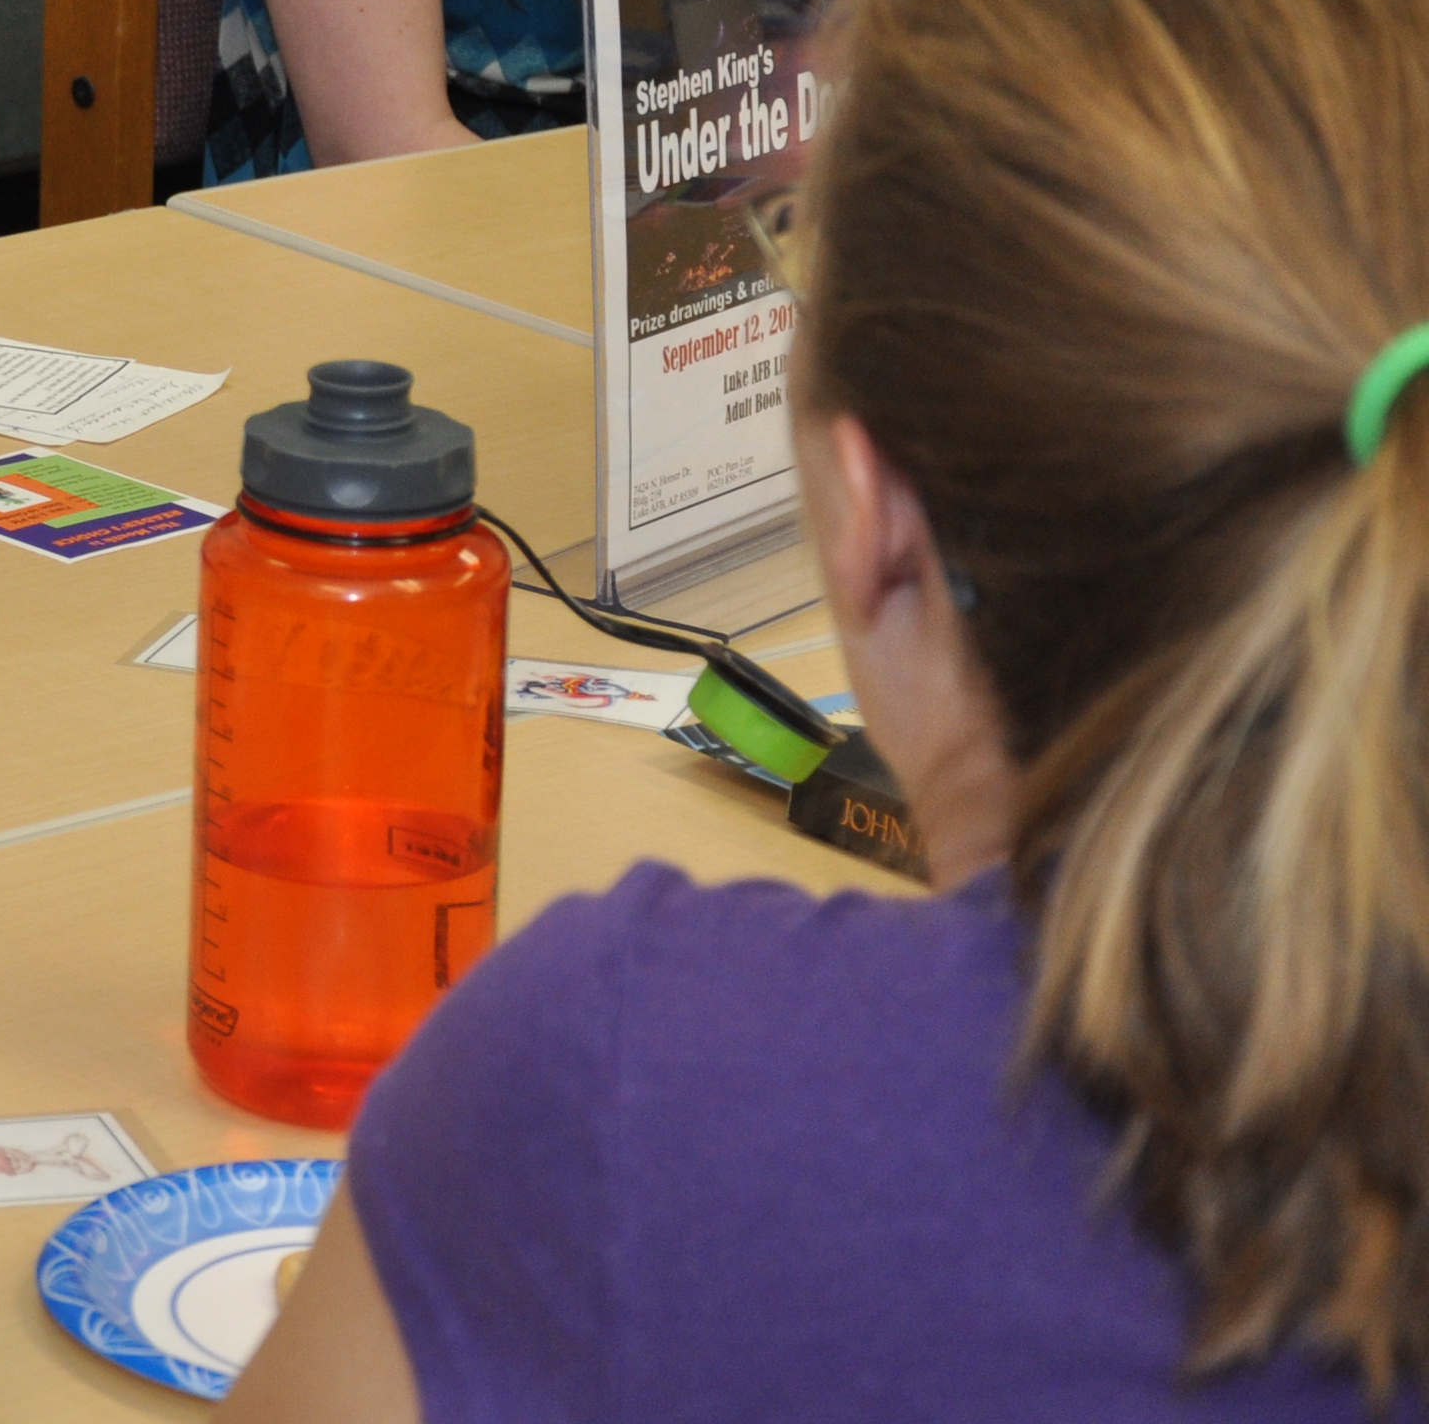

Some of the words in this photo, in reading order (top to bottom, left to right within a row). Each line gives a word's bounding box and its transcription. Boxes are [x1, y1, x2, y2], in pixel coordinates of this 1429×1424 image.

[636, 68, 713, 115] Stephen
[717, 43, 774, 88] King's
[637, 107, 731, 194] Under
[739, 87, 789, 161] the
[630, 314, 666, 338] Prize
[669, 290, 733, 324] drawings
[737, 281, 748, 300] &
[663, 325, 739, 374] September
[743, 315, 764, 345] 12,
[769, 302, 796, 336] 201
[723, 370, 749, 395] Luke
[752, 359, 771, 384] AFB
[725, 397, 752, 425] Adult
[755, 387, 782, 414] Book
[840, 797, 910, 851] JOHN
